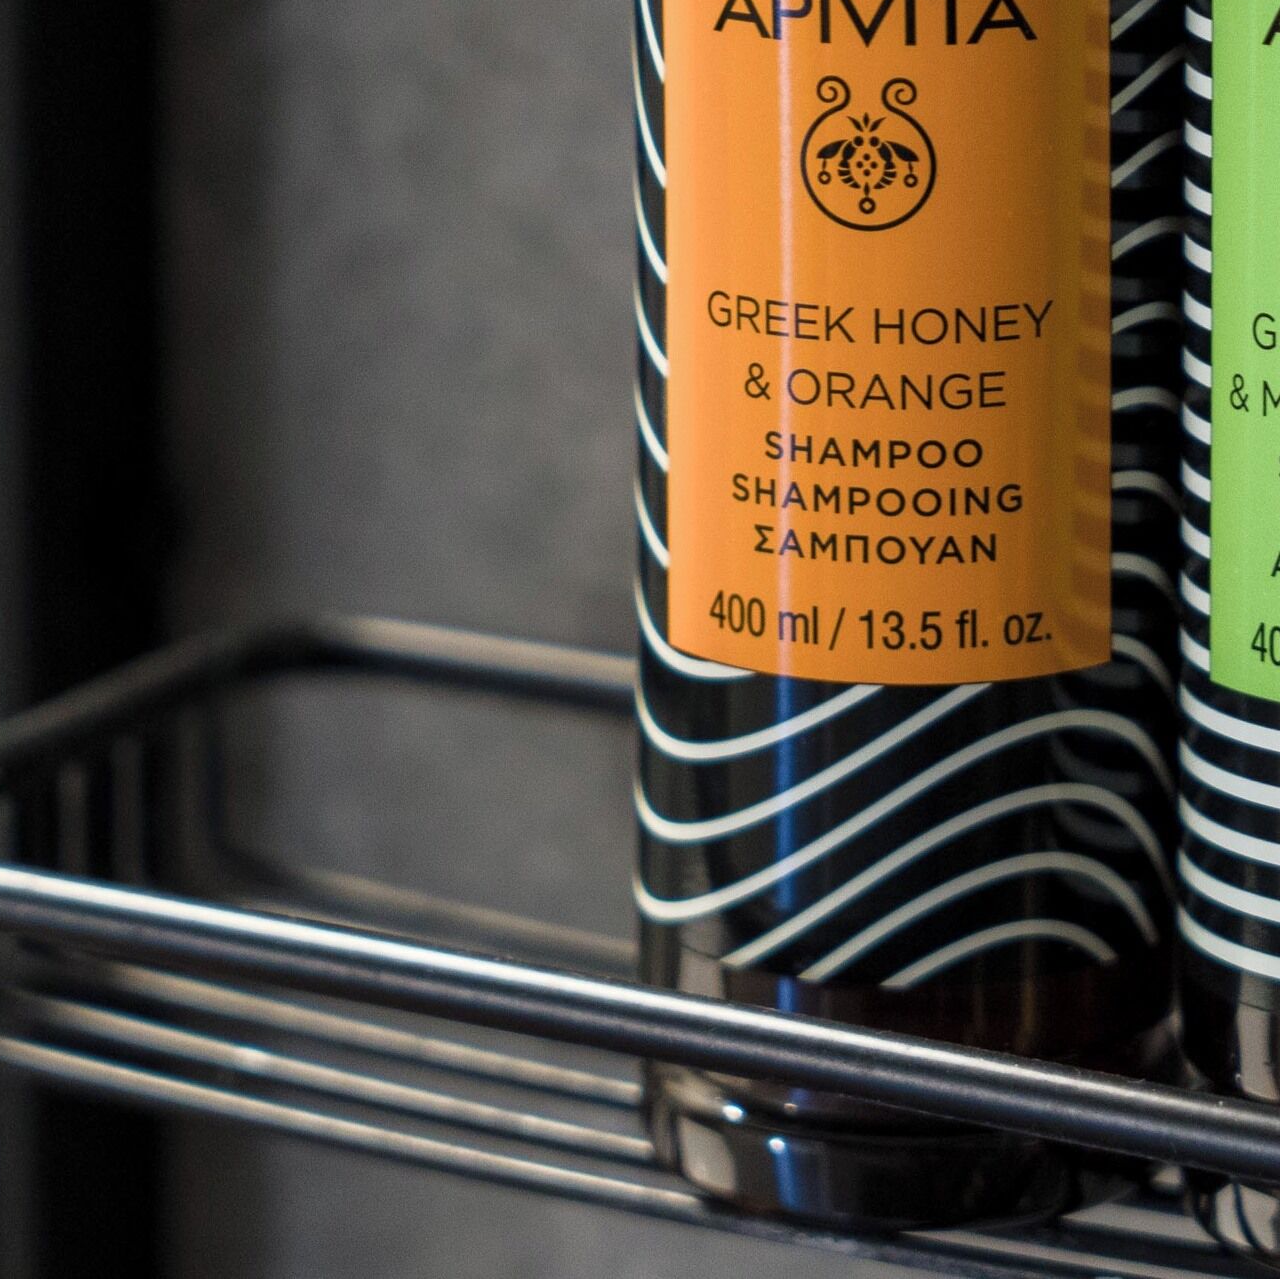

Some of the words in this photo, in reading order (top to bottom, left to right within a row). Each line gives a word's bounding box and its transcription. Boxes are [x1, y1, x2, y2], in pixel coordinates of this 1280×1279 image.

[708, 291, 855, 343] GREEK
[874, 300, 1053, 345] HONEY
[745, 363, 771, 400] &
[787, 369, 1006, 410] ORANGE
[1230, 374, 1249, 412] &
[765, 431, 983, 469] SHAMPOO
[733, 473, 1022, 517] SHAMPOOING
[754, 524, 996, 564] ΣΑΜΠΟΥΑΝ
[710, 590, 765, 637] 400
[779, 606, 818, 644] ml
[829, 607, 845, 650] /
[859, 610, 943, 650] 13.5
[955, 609, 988, 649] fl.
[1003, 612, 1052, 645] oz.
